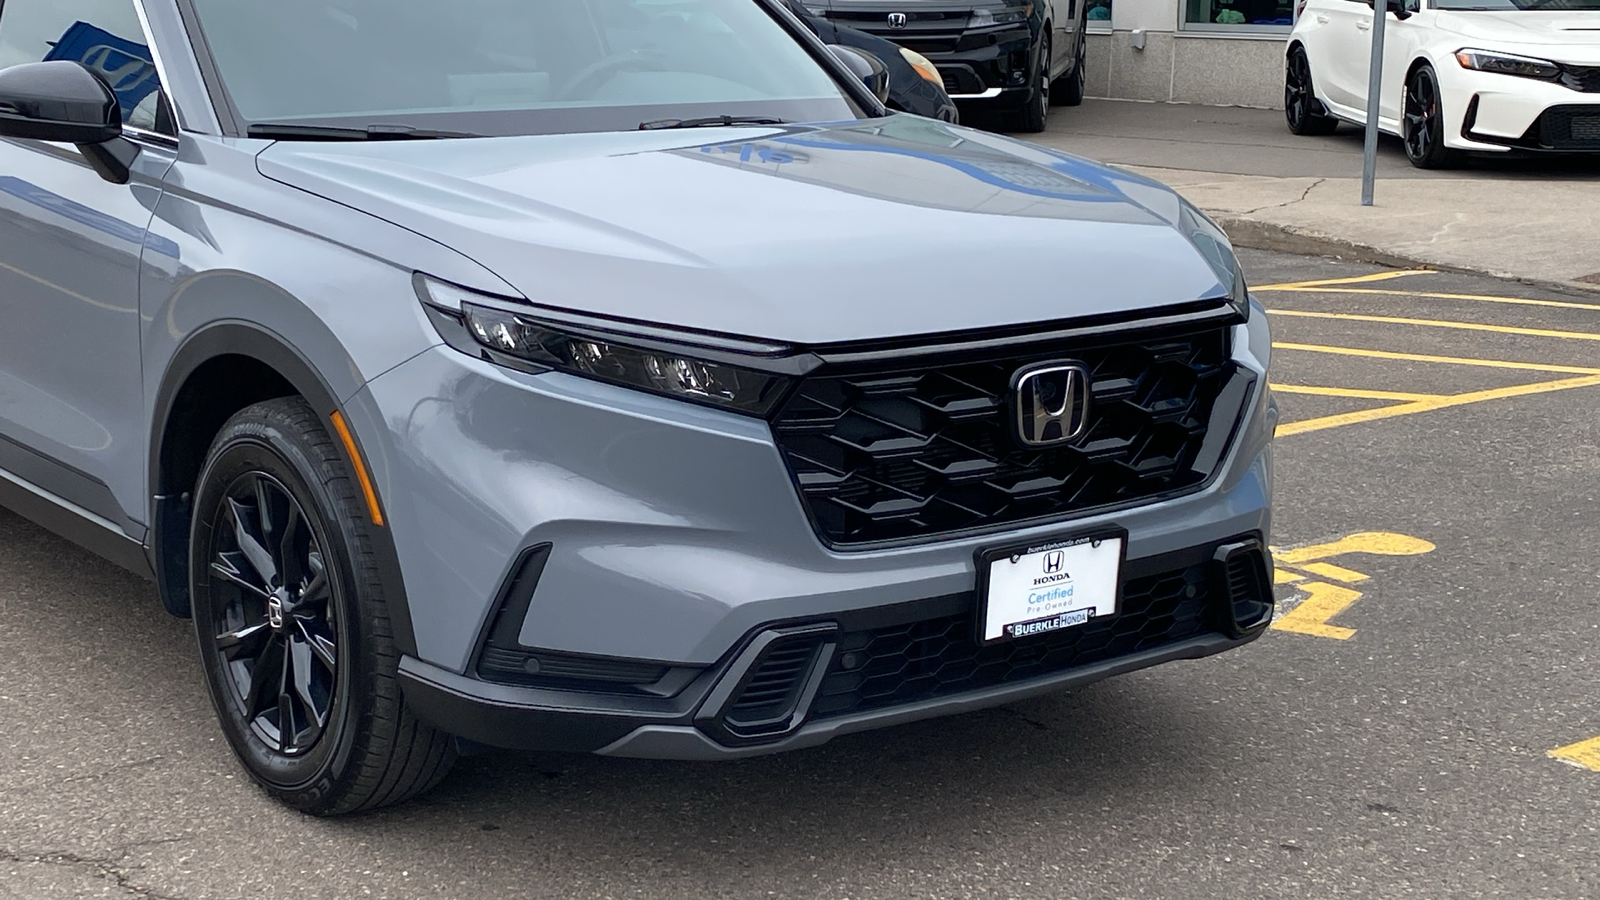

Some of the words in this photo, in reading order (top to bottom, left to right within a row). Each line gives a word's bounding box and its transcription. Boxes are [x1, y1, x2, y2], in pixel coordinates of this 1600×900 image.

[1033, 572, 1070, 585] HONDA
[1028, 584, 1073, 604] Certified
[1014, 618, 1060, 636] BUERKLE
[1060, 613, 1087, 627] HONDA
